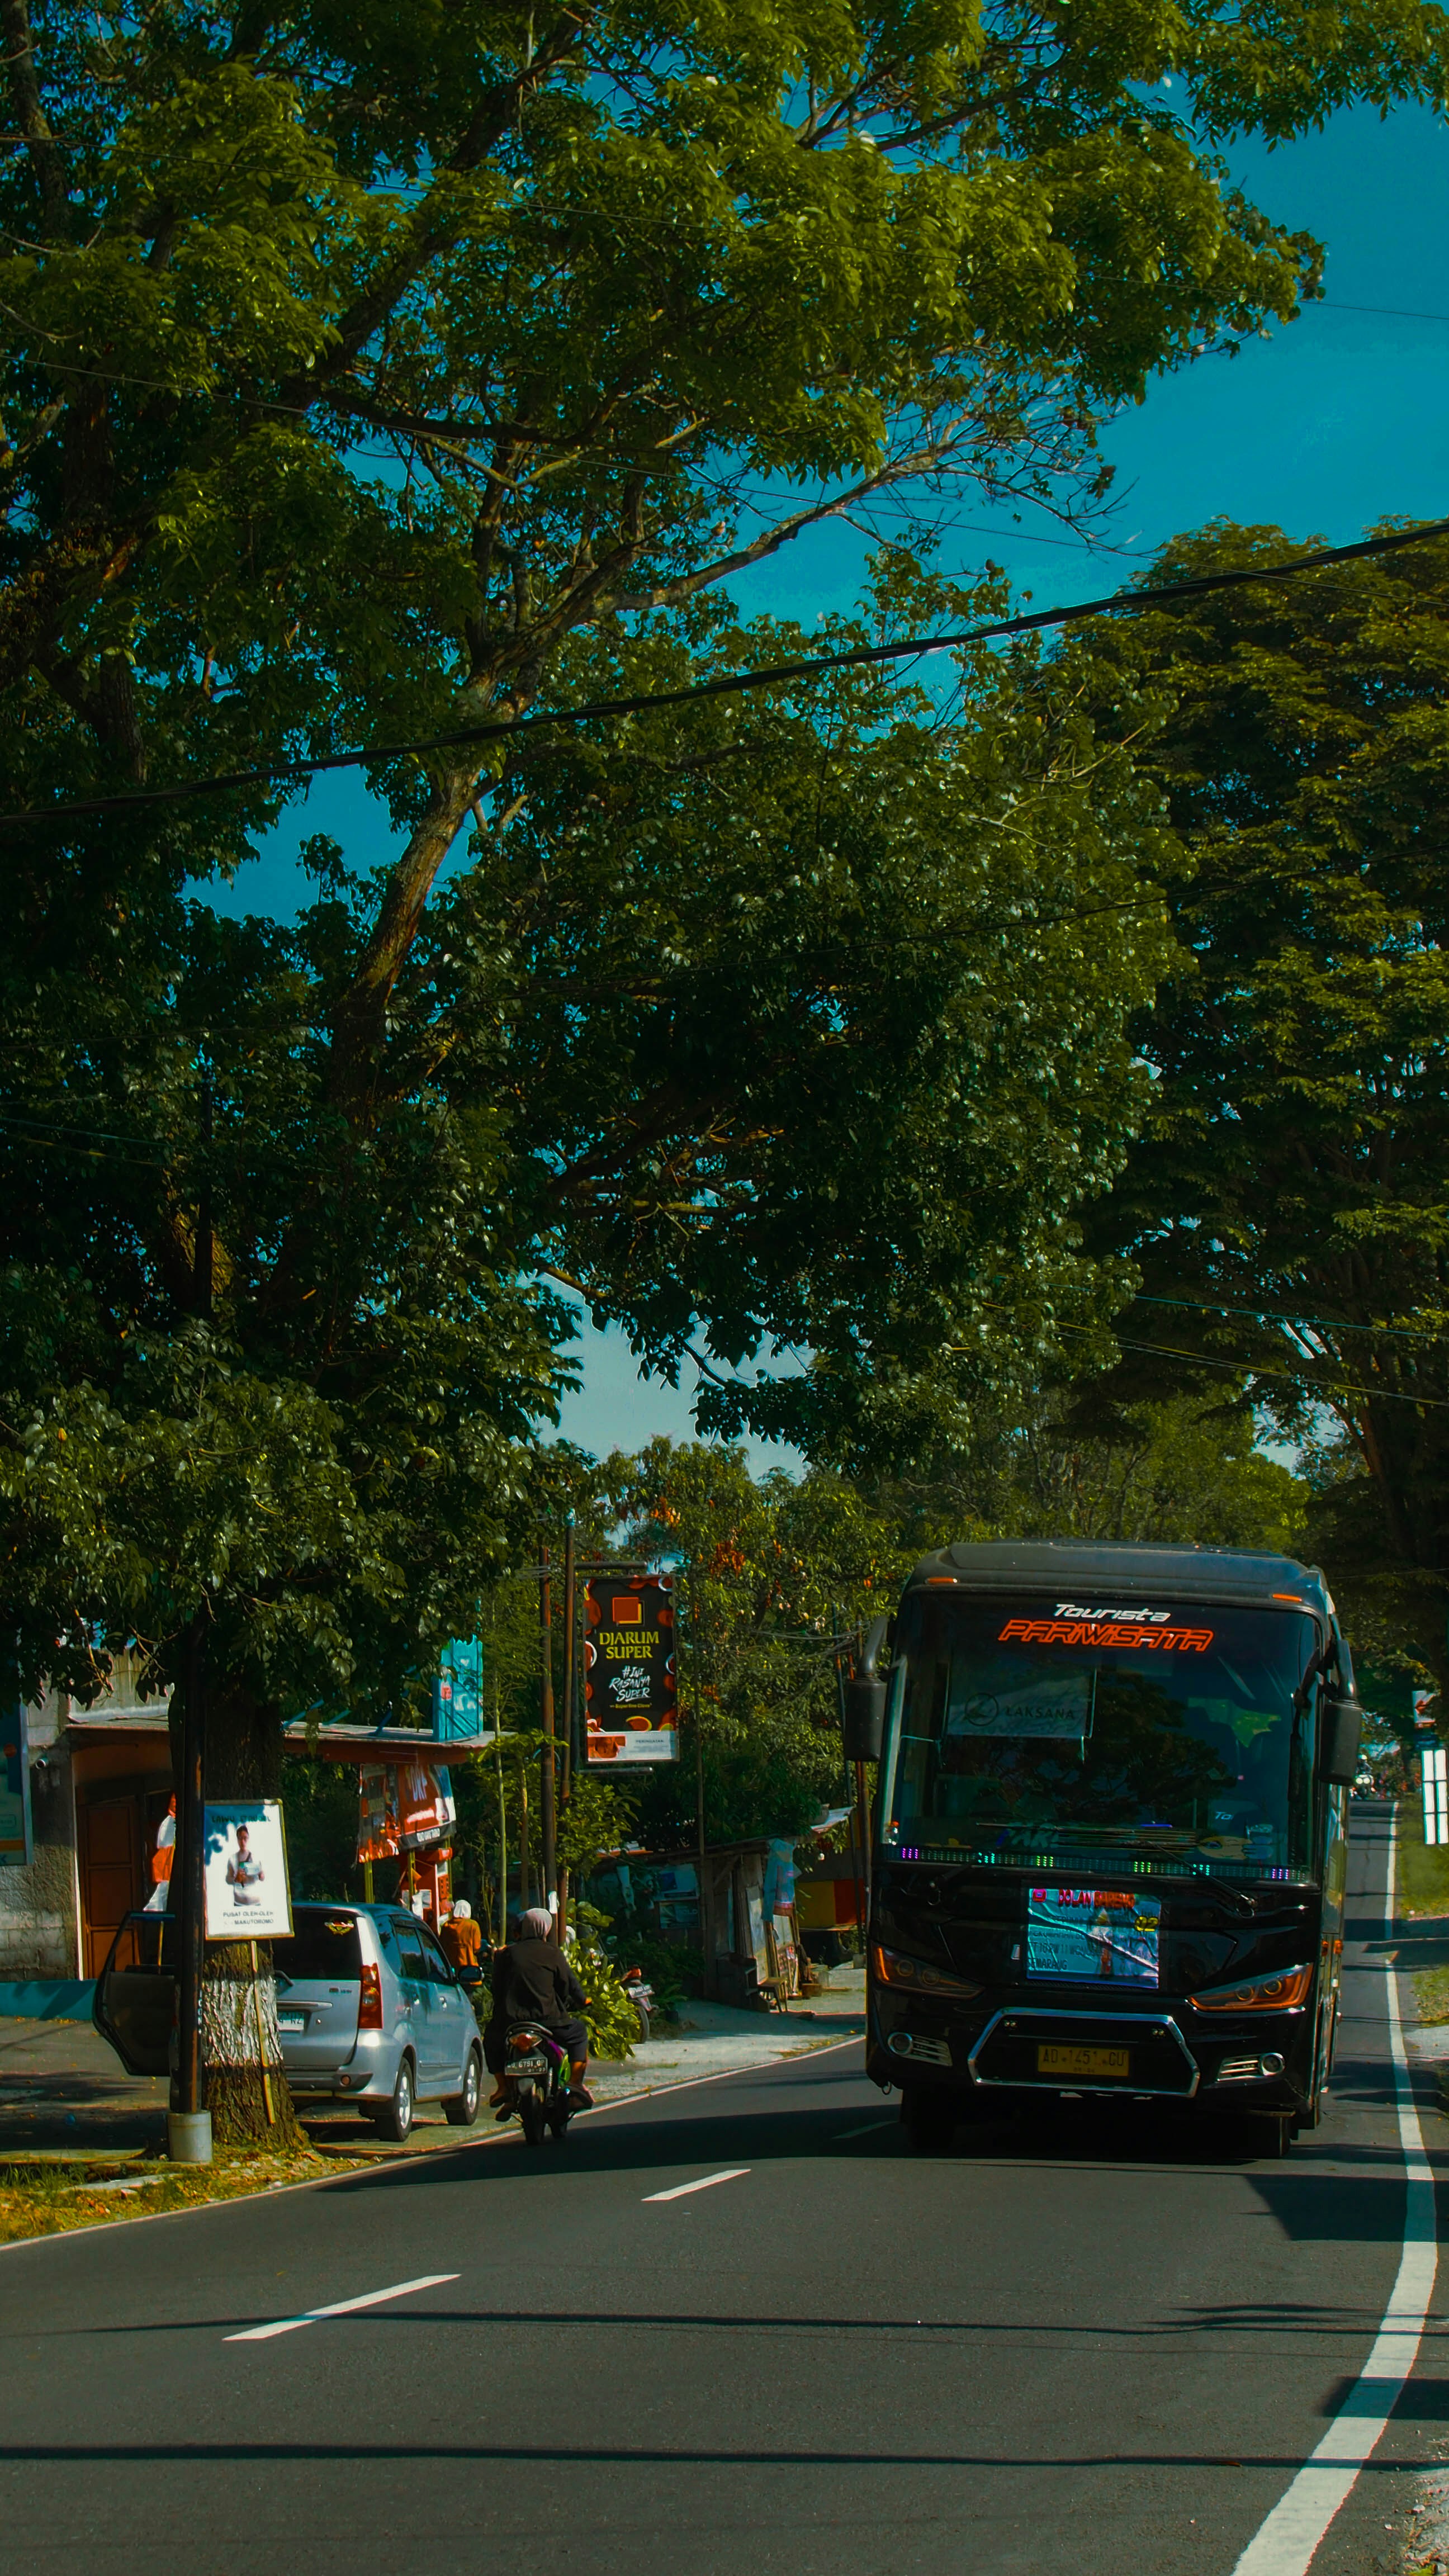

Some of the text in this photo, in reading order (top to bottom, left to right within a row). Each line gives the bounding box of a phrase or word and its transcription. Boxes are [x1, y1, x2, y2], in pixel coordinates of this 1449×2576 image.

[1053, 1603, 1171, 1622] Tourista
[599, 1631, 660, 1646] DJARUM
[605, 1645, 654, 1659] SUPER
[1006, 1707, 1074, 1720] LAKSANA
[1043, 2048, 1058, 2063] AD
